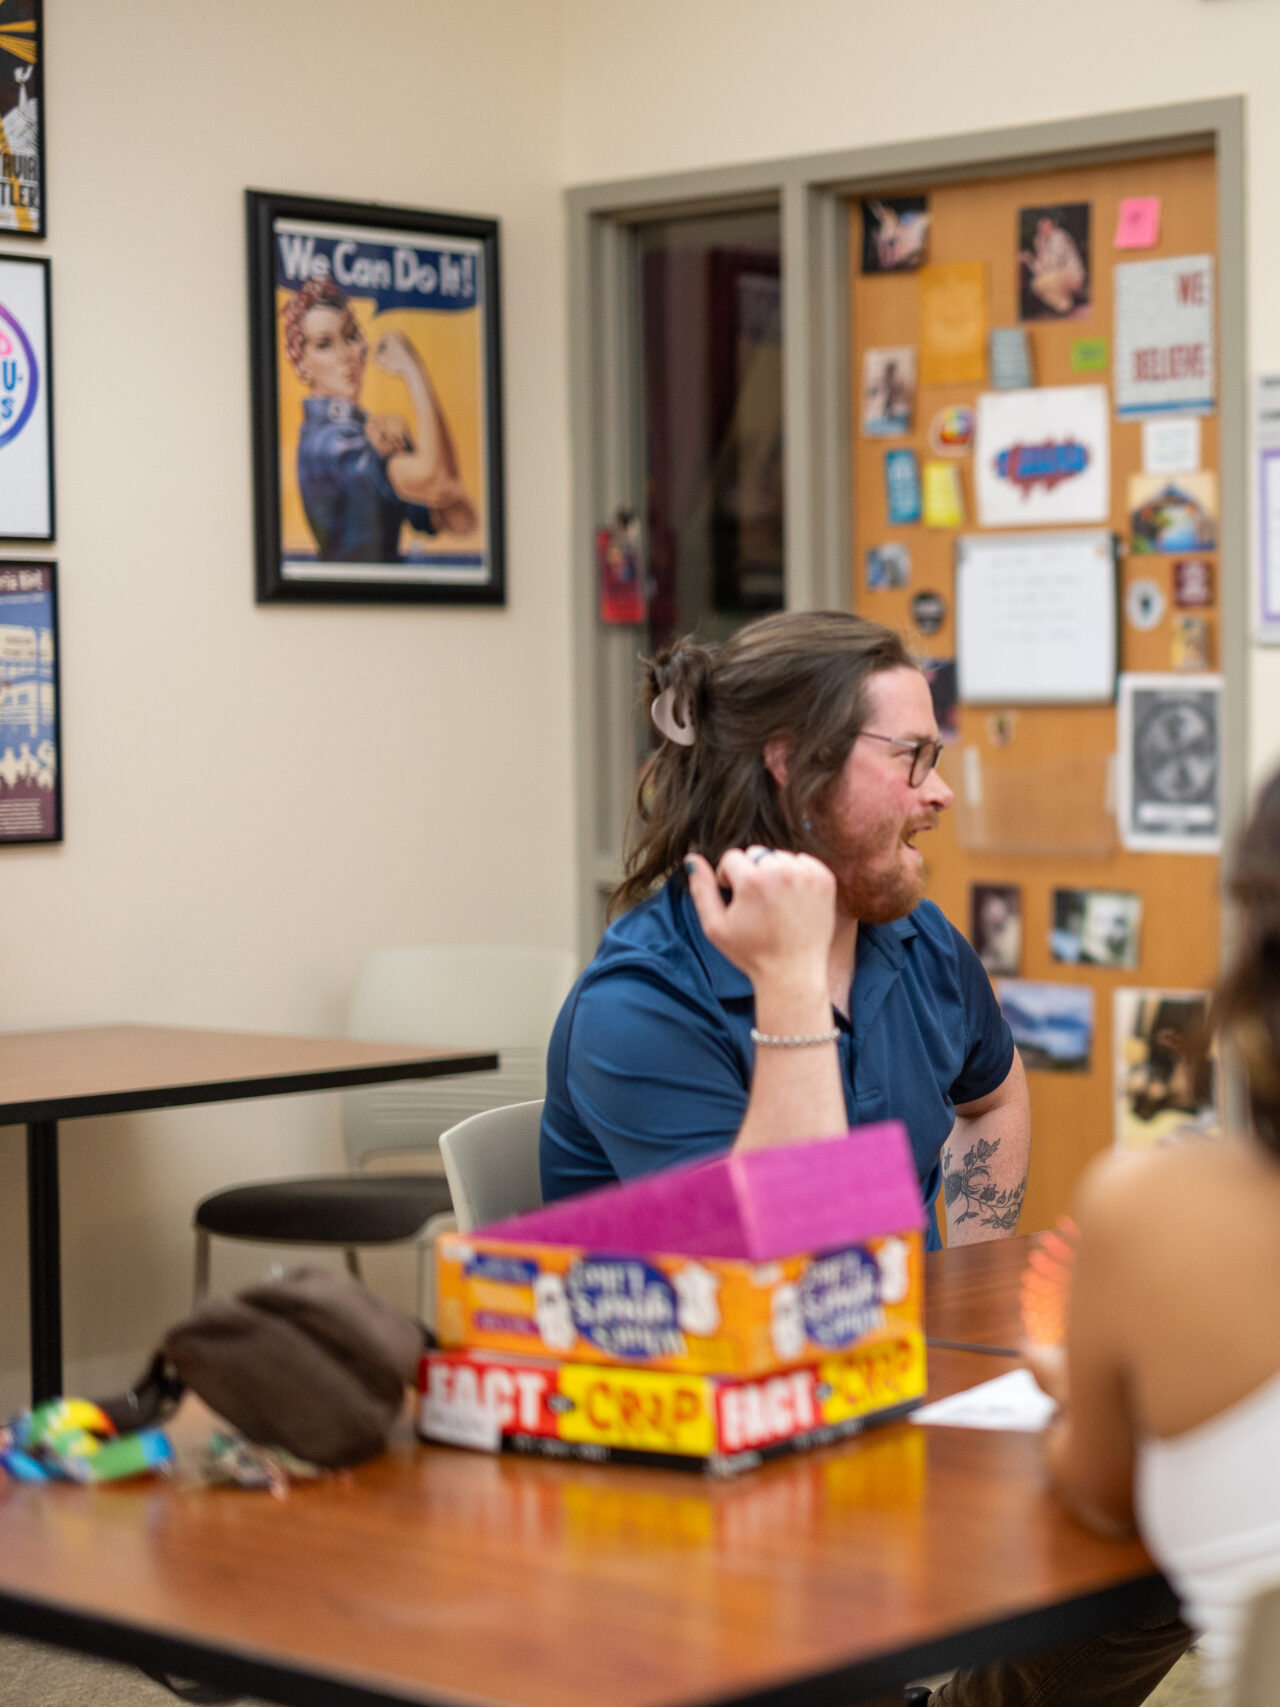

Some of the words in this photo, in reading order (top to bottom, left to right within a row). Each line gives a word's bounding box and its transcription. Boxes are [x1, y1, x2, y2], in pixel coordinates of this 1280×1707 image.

[278, 234, 331, 282] We
[332, 240, 392, 290] Can
[393, 246, 438, 294] Do
[438, 253, 475, 299] It!
[426, 1363, 547, 1432] FACT
[721, 1368, 814, 1450] FACT
